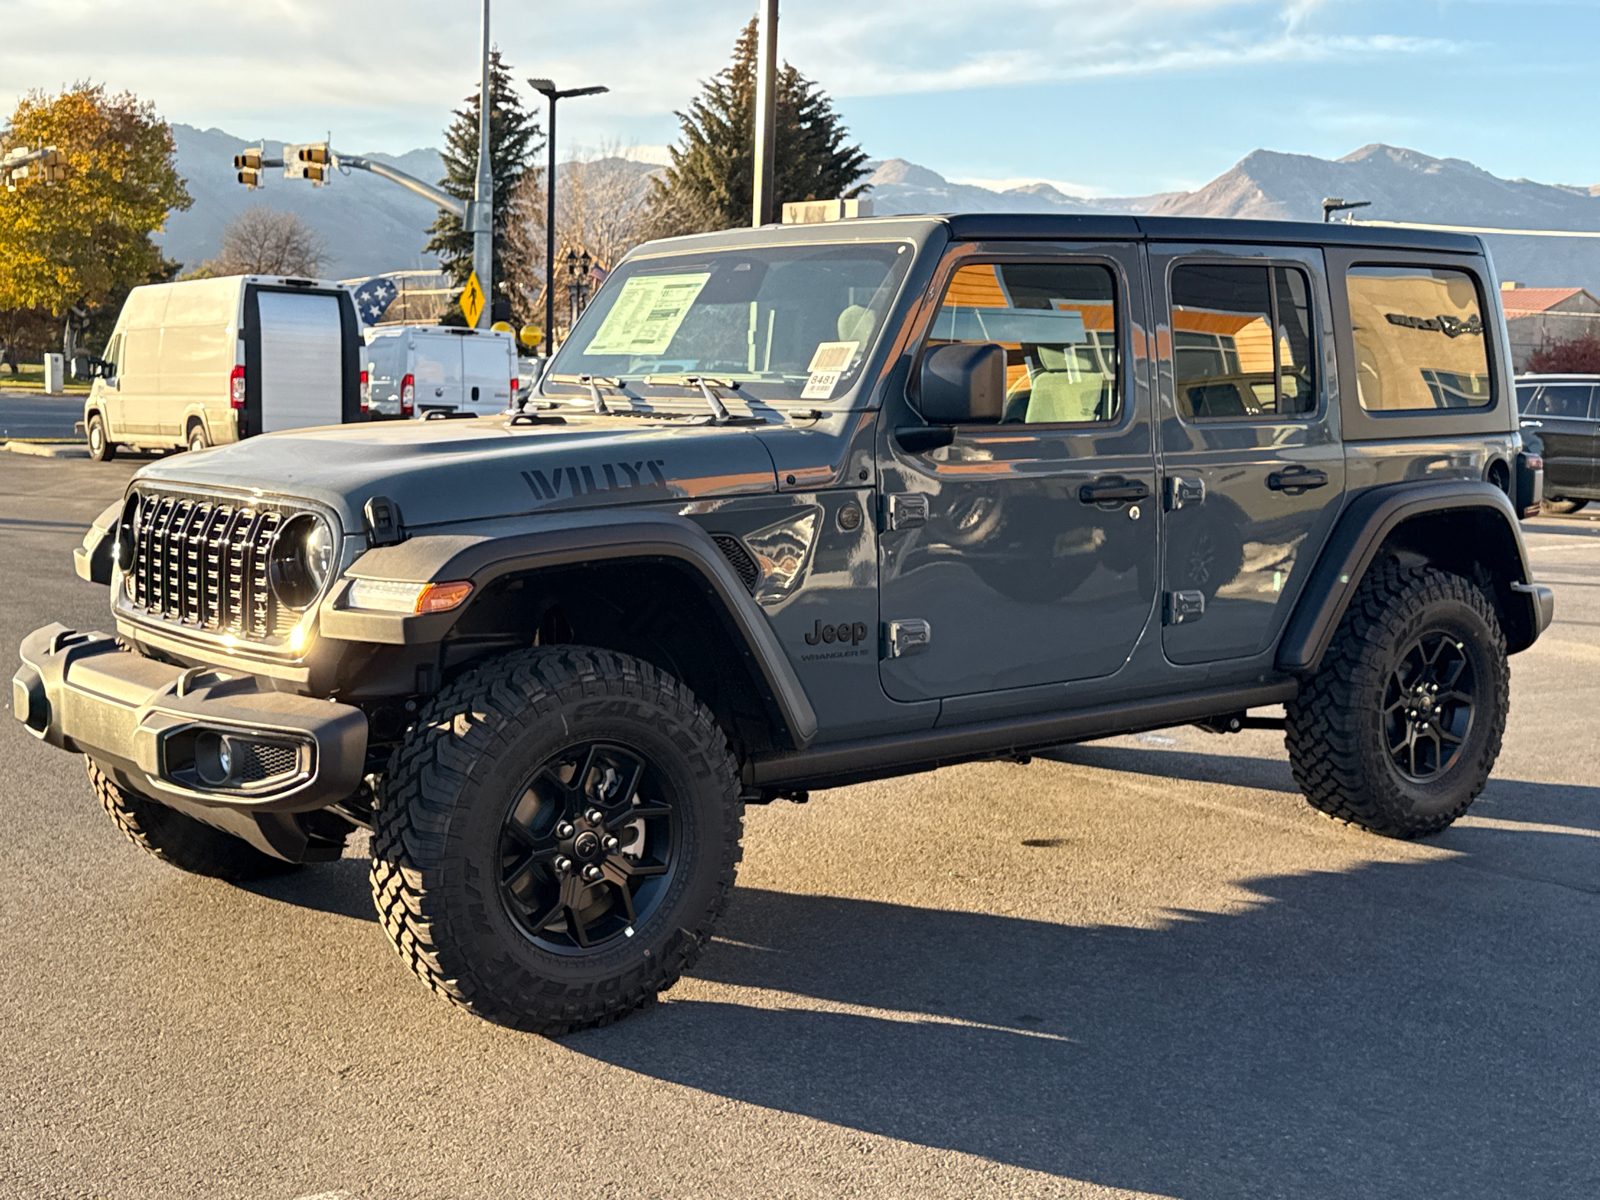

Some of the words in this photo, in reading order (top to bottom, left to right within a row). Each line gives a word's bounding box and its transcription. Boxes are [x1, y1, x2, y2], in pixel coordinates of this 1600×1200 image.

[810, 375, 835, 385] 8481
[520, 459, 667, 500] WILLYS
[805, 619, 868, 646] Jeep
[801, 650, 858, 661] WRANGLER
